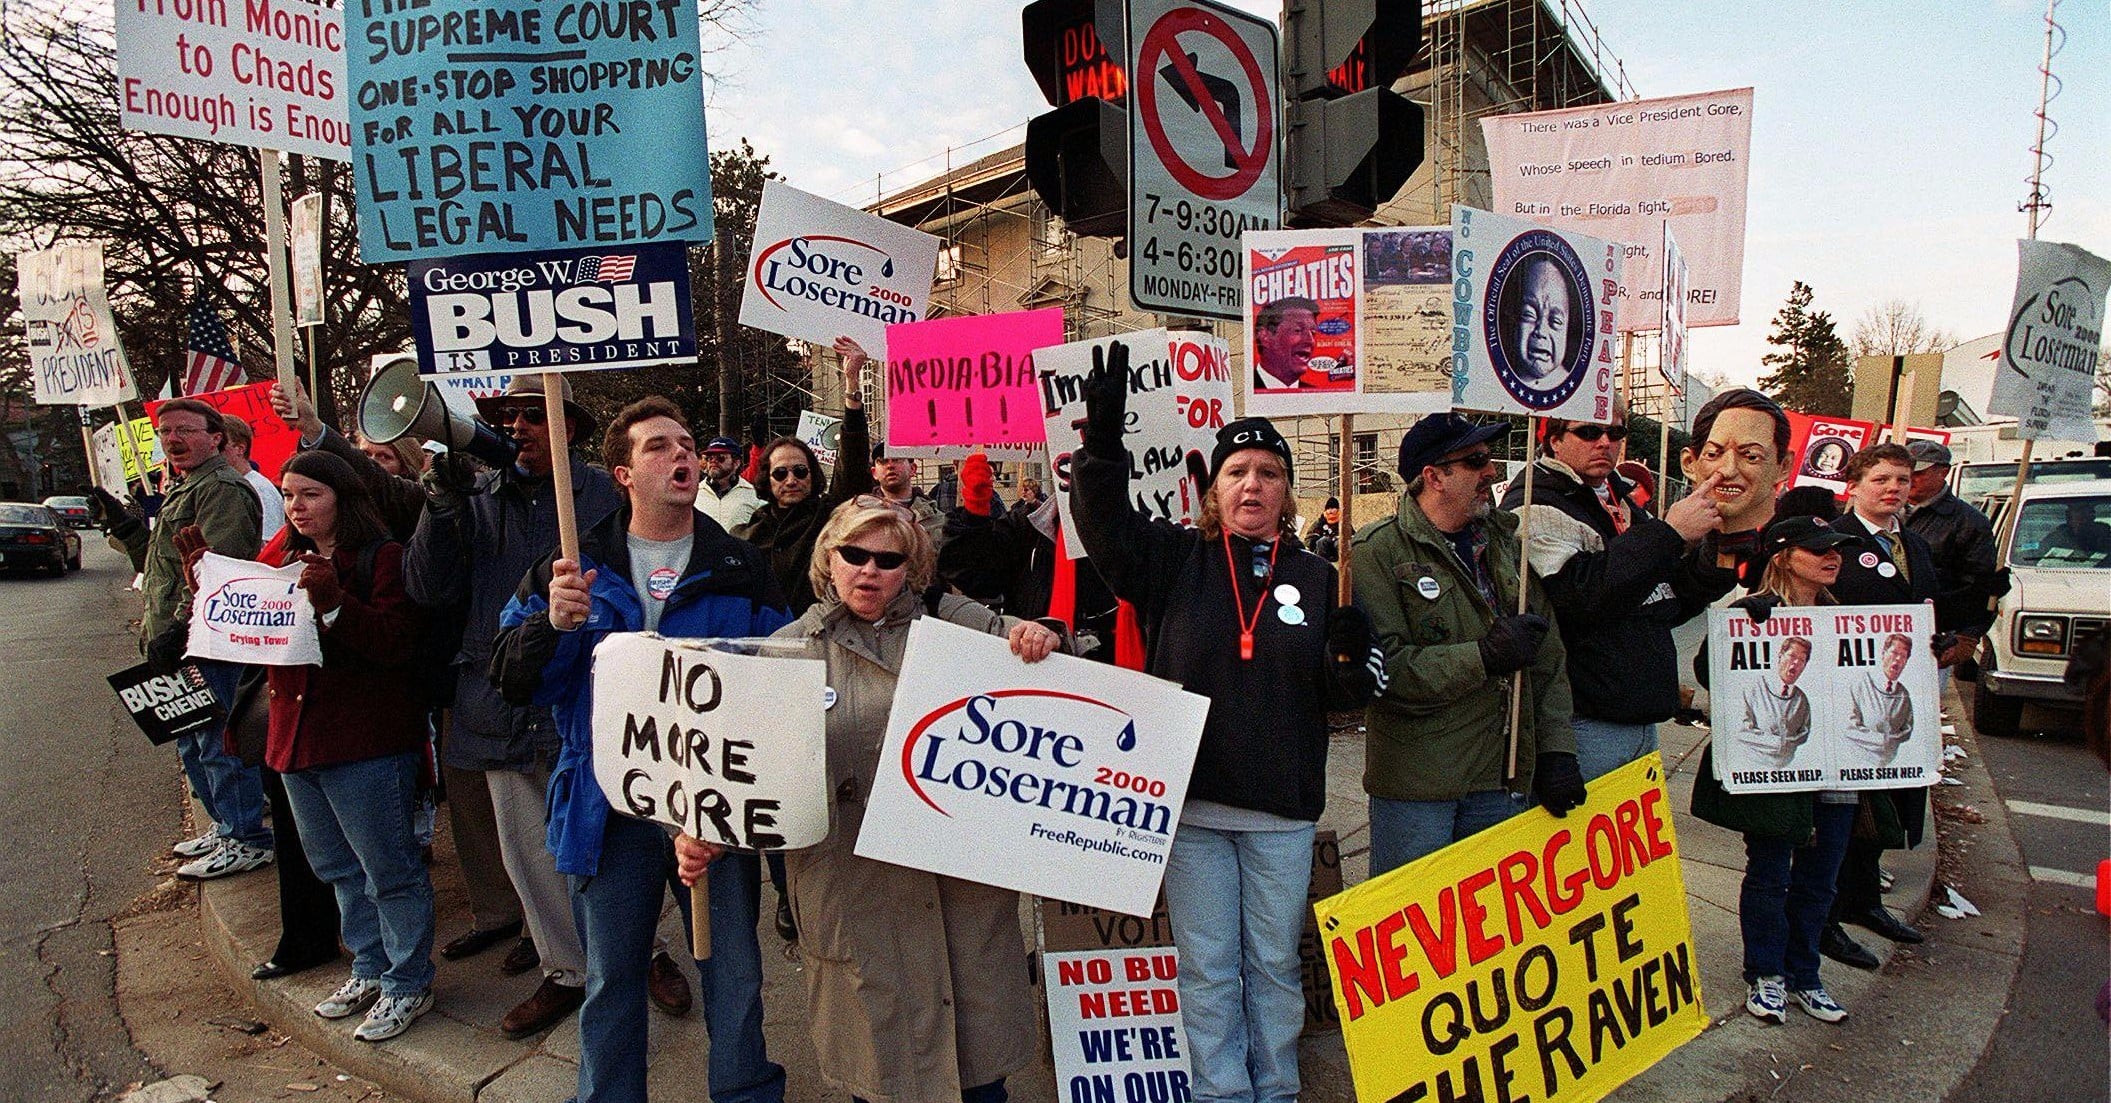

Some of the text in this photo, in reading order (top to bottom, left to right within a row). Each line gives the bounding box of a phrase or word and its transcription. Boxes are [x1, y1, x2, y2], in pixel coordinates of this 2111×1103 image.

[246, 0, 342, 52] Monic
[366, 0, 681, 64] SUPREME COURT
[177, 33, 335, 101] to Chads
[531, 53, 695, 96] SHOPPING
[124, 77, 236, 136] Enough
[249, 97, 273, 133] is
[433, 109, 501, 136] ALL
[512, 103, 621, 138] YOUR
[1520, 103, 1743, 134] There was a Vice President Gore,
[364, 140, 612, 203] LIBERAL
[1519, 150, 1736, 177] Whose speech in tedium Bored.
[379, 188, 698, 252] LEGAL NEEDS
[1514, 200, 1672, 217] But in the Florida fight,
[787, 236, 864, 286] Sore
[1143, 236, 1243, 280] 4-6:30
[1497, 252, 1514, 278] Seal
[1511, 241, 1522, 258] of
[1520, 236, 1534, 251] the
[1533, 233, 1561, 252] United
[423, 259, 574, 294] George W.
[764, 259, 918, 324] Loserman
[1144, 274, 1244, 308] MONDAY-FRI
[1253, 252, 1354, 305] CHEATIES
[869, 284, 914, 308] 2000
[2041, 289, 2078, 331] Sore
[426, 280, 681, 353] BUSH
[448, 340, 681, 371] IS PRESIDENT
[2018, 324, 2099, 376] Loserman
[447, 375, 496, 389] WHAT
[1232, 429, 1286, 452] CIA
[1811, 422, 1864, 441] Gore
[206, 599, 297, 627] Loserman
[221, 583, 258, 609] Sore
[260, 599, 294, 611] 2000
[229, 633, 261, 646] Crying
[1728, 616, 1813, 637] IT'S OVER
[1834, 613, 1914, 634] IT'S OVER
[1729, 640, 1772, 671] AL!
[1837, 637, 1877, 667] AL!
[120, 669, 194, 714] BUSH
[658, 649, 723, 714] NO
[153, 688, 216, 722] CHENEY
[621, 712, 758, 785] MORE
[957, 693, 1085, 769] Sore
[915, 733, 1173, 836] Loserman
[1093, 766, 1168, 798] 2000
[1732, 767, 1825, 785] PLEASE SEEK HELP.
[1839, 765, 1926, 782] PLEASE SEEK HELP.
[621, 767, 788, 849] GORE
[1028, 822, 1164, 866] FreeRepublic.com
[1057, 958, 1113, 987] NO
[1079, 987, 1180, 1019] NEED
[1534, 941, 1694, 1098] RAVEN
[1079, 1025, 1182, 1064] WE'RE
[1070, 1069, 1193, 1103] ON OUR
